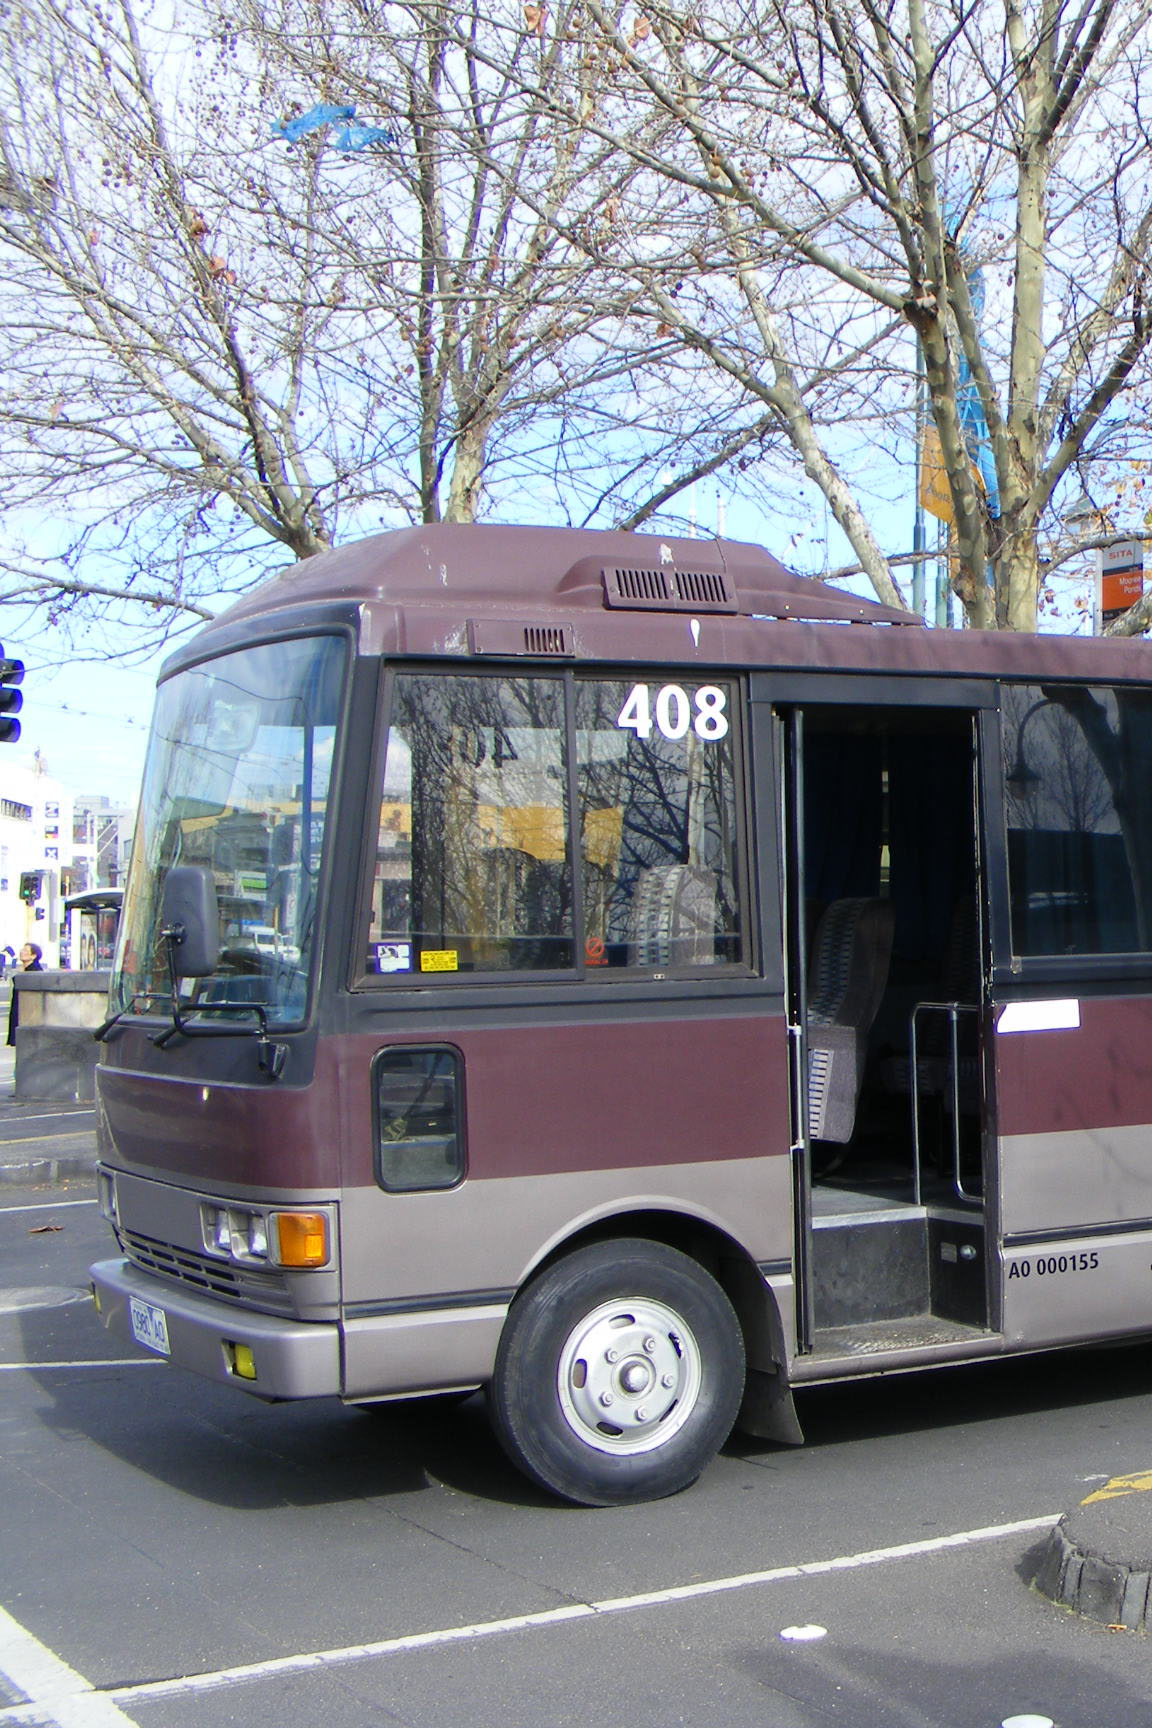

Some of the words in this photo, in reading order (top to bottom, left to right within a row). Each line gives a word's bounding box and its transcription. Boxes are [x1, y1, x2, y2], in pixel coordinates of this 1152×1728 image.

[1109, 549, 1133, 560] SITA
[618, 683, 729, 741] 408
[1036, 1252, 1099, 1276] 000155
